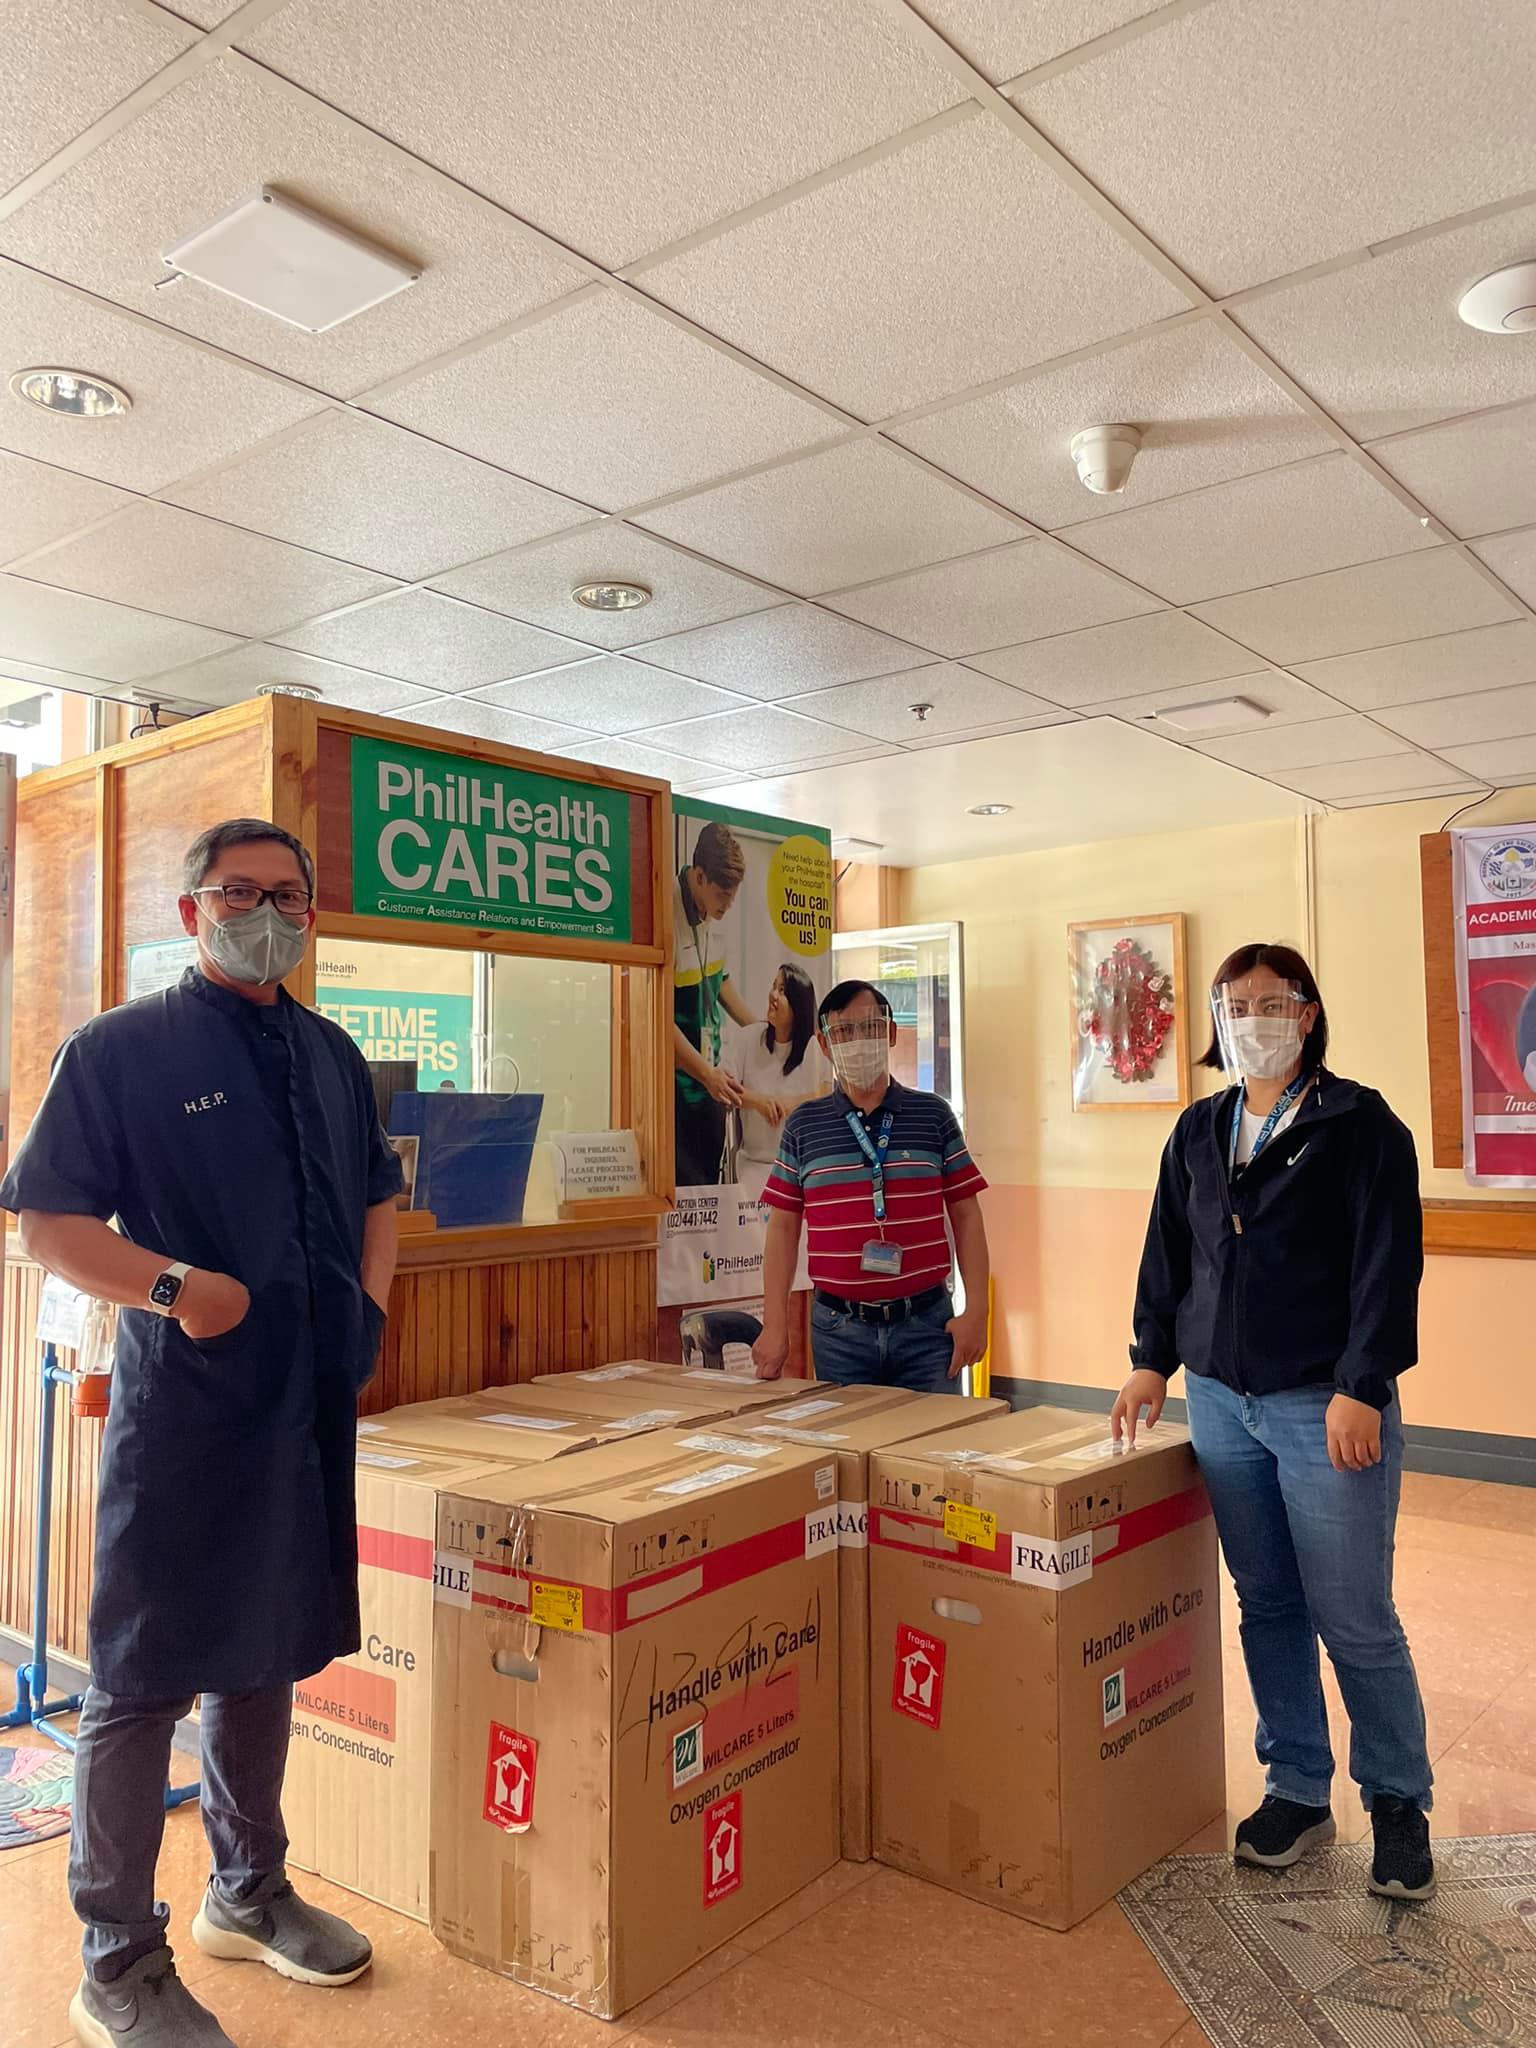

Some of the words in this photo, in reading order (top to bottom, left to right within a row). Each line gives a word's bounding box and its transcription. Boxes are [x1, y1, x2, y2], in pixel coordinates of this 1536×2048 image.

[378, 760, 611, 847] PhilHealth
[377, 819, 613, 913] CARES
[814, 858, 830, 867] abot
[784, 887, 806, 908] You
[809, 895, 829, 912] can
[377, 900, 426, 915] Customer
[427, 905, 477, 921] Assistance
[478, 911, 519, 926] Relations
[520, 918, 536, 928] and
[537, 917, 595, 934] Empowerment
[596, 923, 615, 935] Staff
[781, 908, 816, 928] count
[818, 915, 832, 930] on
[799, 929, 817, 946] us!
[184, 1092, 227, 1114] H.E.P.
[676, 1199, 697, 1209] ACTION
[698, 1197, 719, 1208] CENTER
[808, 1518, 836, 1544] FRA
[1016, 1544, 1091, 1576] FRAGILE
[907, 1632, 936, 1652] fragile
[1083, 1620, 1136, 1668] Handle
[1139, 1601, 1169, 1636] with
[1173, 1588, 1203, 1618] Care
[367, 1634, 416, 1672] Care
[648, 1666, 722, 1724] Handle
[728, 1642, 768, 1682] with
[776, 1624, 817, 1658] Care
[294, 1689, 346, 1719] WILCARE
[349, 1708, 356, 1722] 5
[358, 1711, 389, 1734] Liters
[1126, 1682, 1163, 1715] WILCARE
[1164, 1678, 1170, 1691] 5
[498, 1730, 528, 1753] fragile
[703, 1729, 755, 1772] WILCARE
[757, 1723, 765, 1739] 5
[766, 1710, 795, 1735] Liters
[1100, 1728, 1137, 1761] Oxygen
[1139, 1691, 1194, 1737] Concentrator
[312, 1724, 395, 1768] Concentrator
[670, 1784, 720, 1825] Oxygen
[723, 1737, 801, 1792] Concentrator
[711, 1801, 735, 1821] fragile
